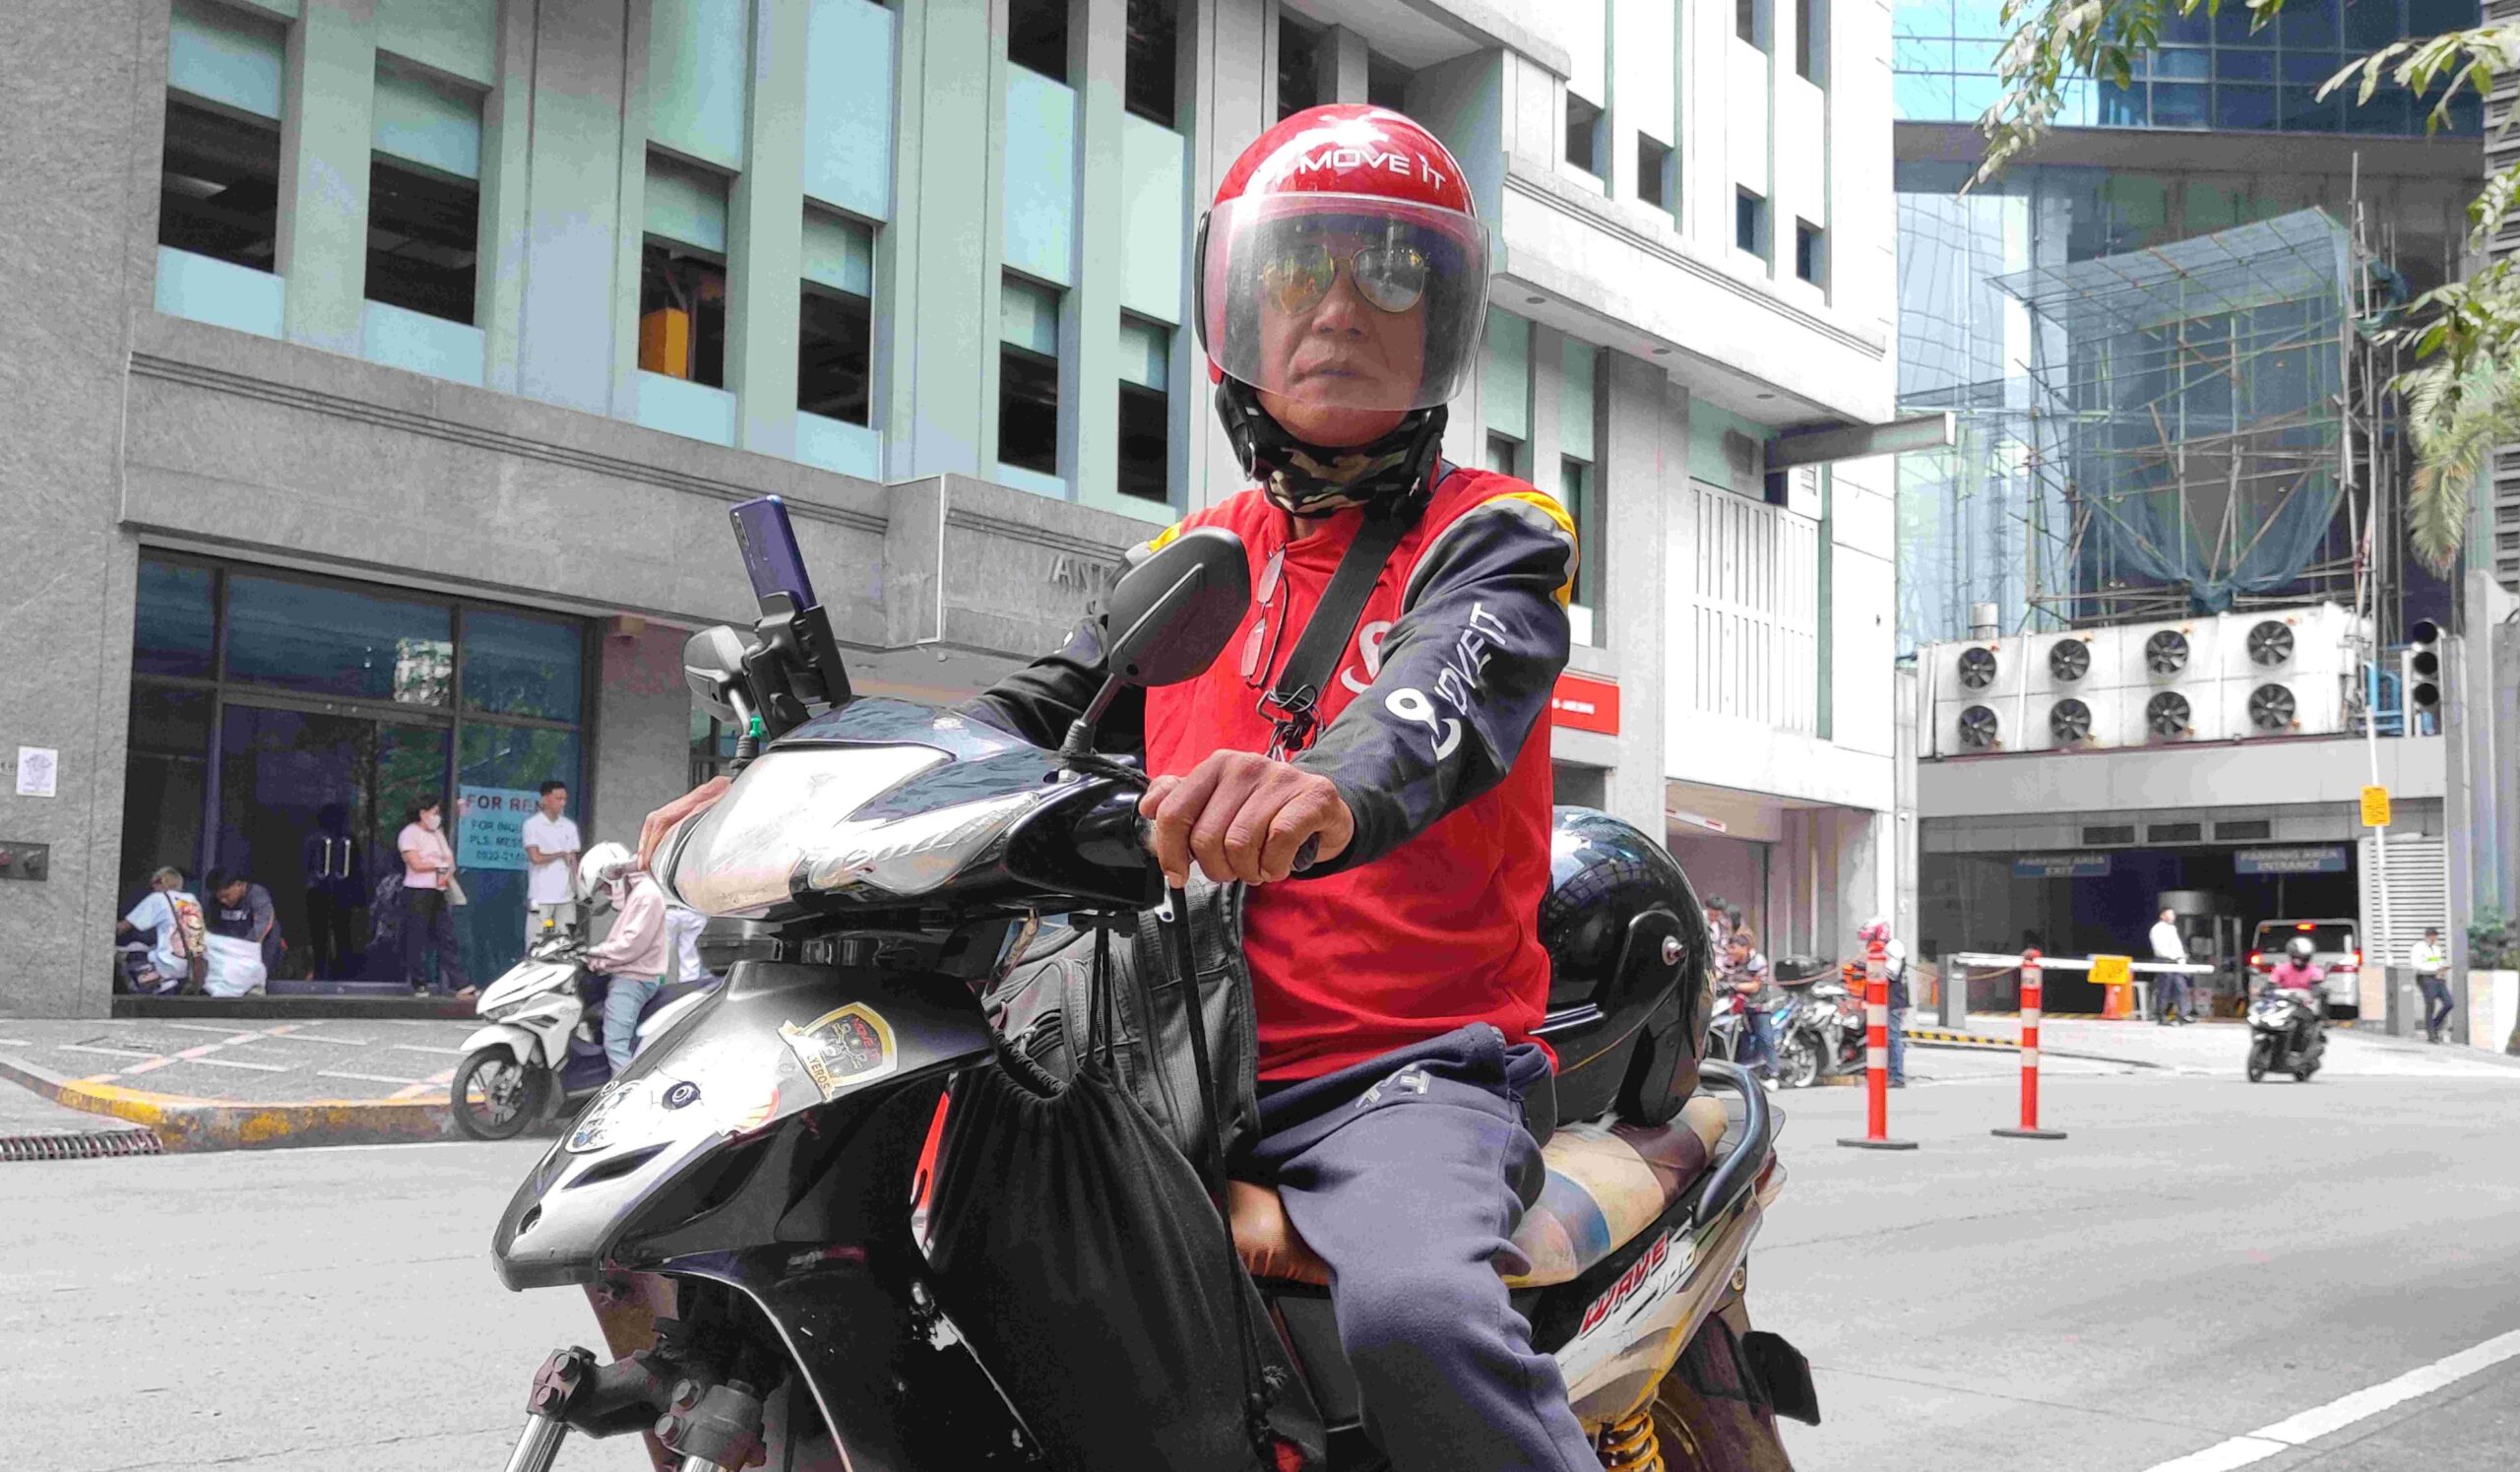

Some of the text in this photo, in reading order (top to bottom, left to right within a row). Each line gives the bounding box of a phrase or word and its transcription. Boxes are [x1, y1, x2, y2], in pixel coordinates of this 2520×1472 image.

[1298, 148, 1411, 175] MOVE
[1433, 628, 1492, 716] OVE
[467, 794, 542, 813] FOR REN
[472, 819, 493, 831] FOR
[1579, 1231, 1669, 1337] WAVE
